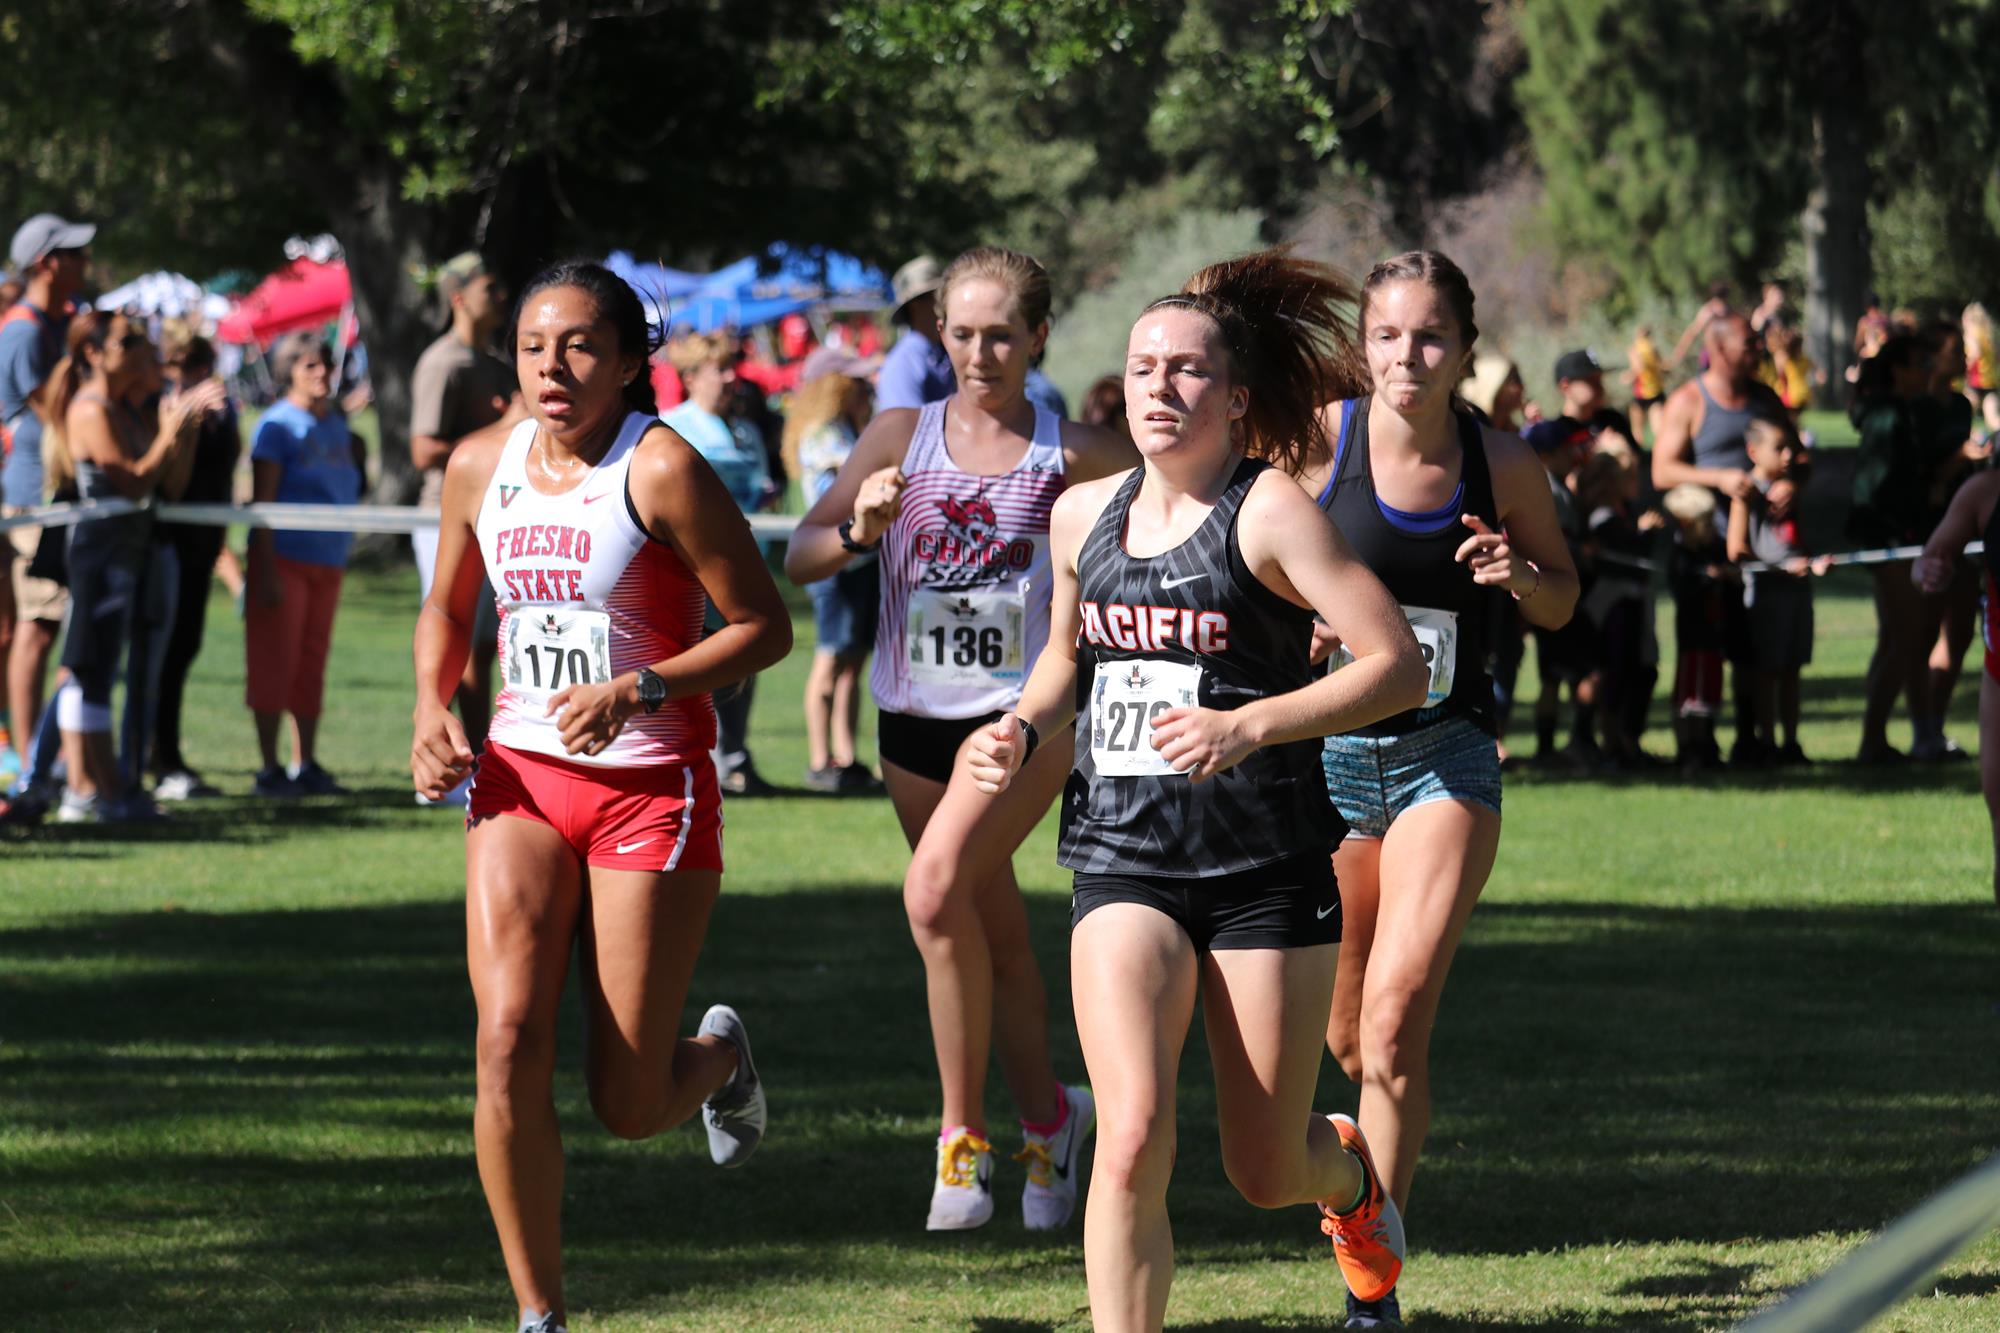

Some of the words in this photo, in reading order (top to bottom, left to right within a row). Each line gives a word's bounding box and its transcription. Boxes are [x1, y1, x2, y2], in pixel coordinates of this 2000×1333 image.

[500, 484, 521, 509] V
[496, 524, 592, 565] FRESNO
[912, 531, 1034, 572] CHICO
[504, 569, 585, 601] STATE
[928, 625, 1004, 669] 136
[1076, 601, 1229, 653] ACIFIC
[524, 644, 591, 690] 170
